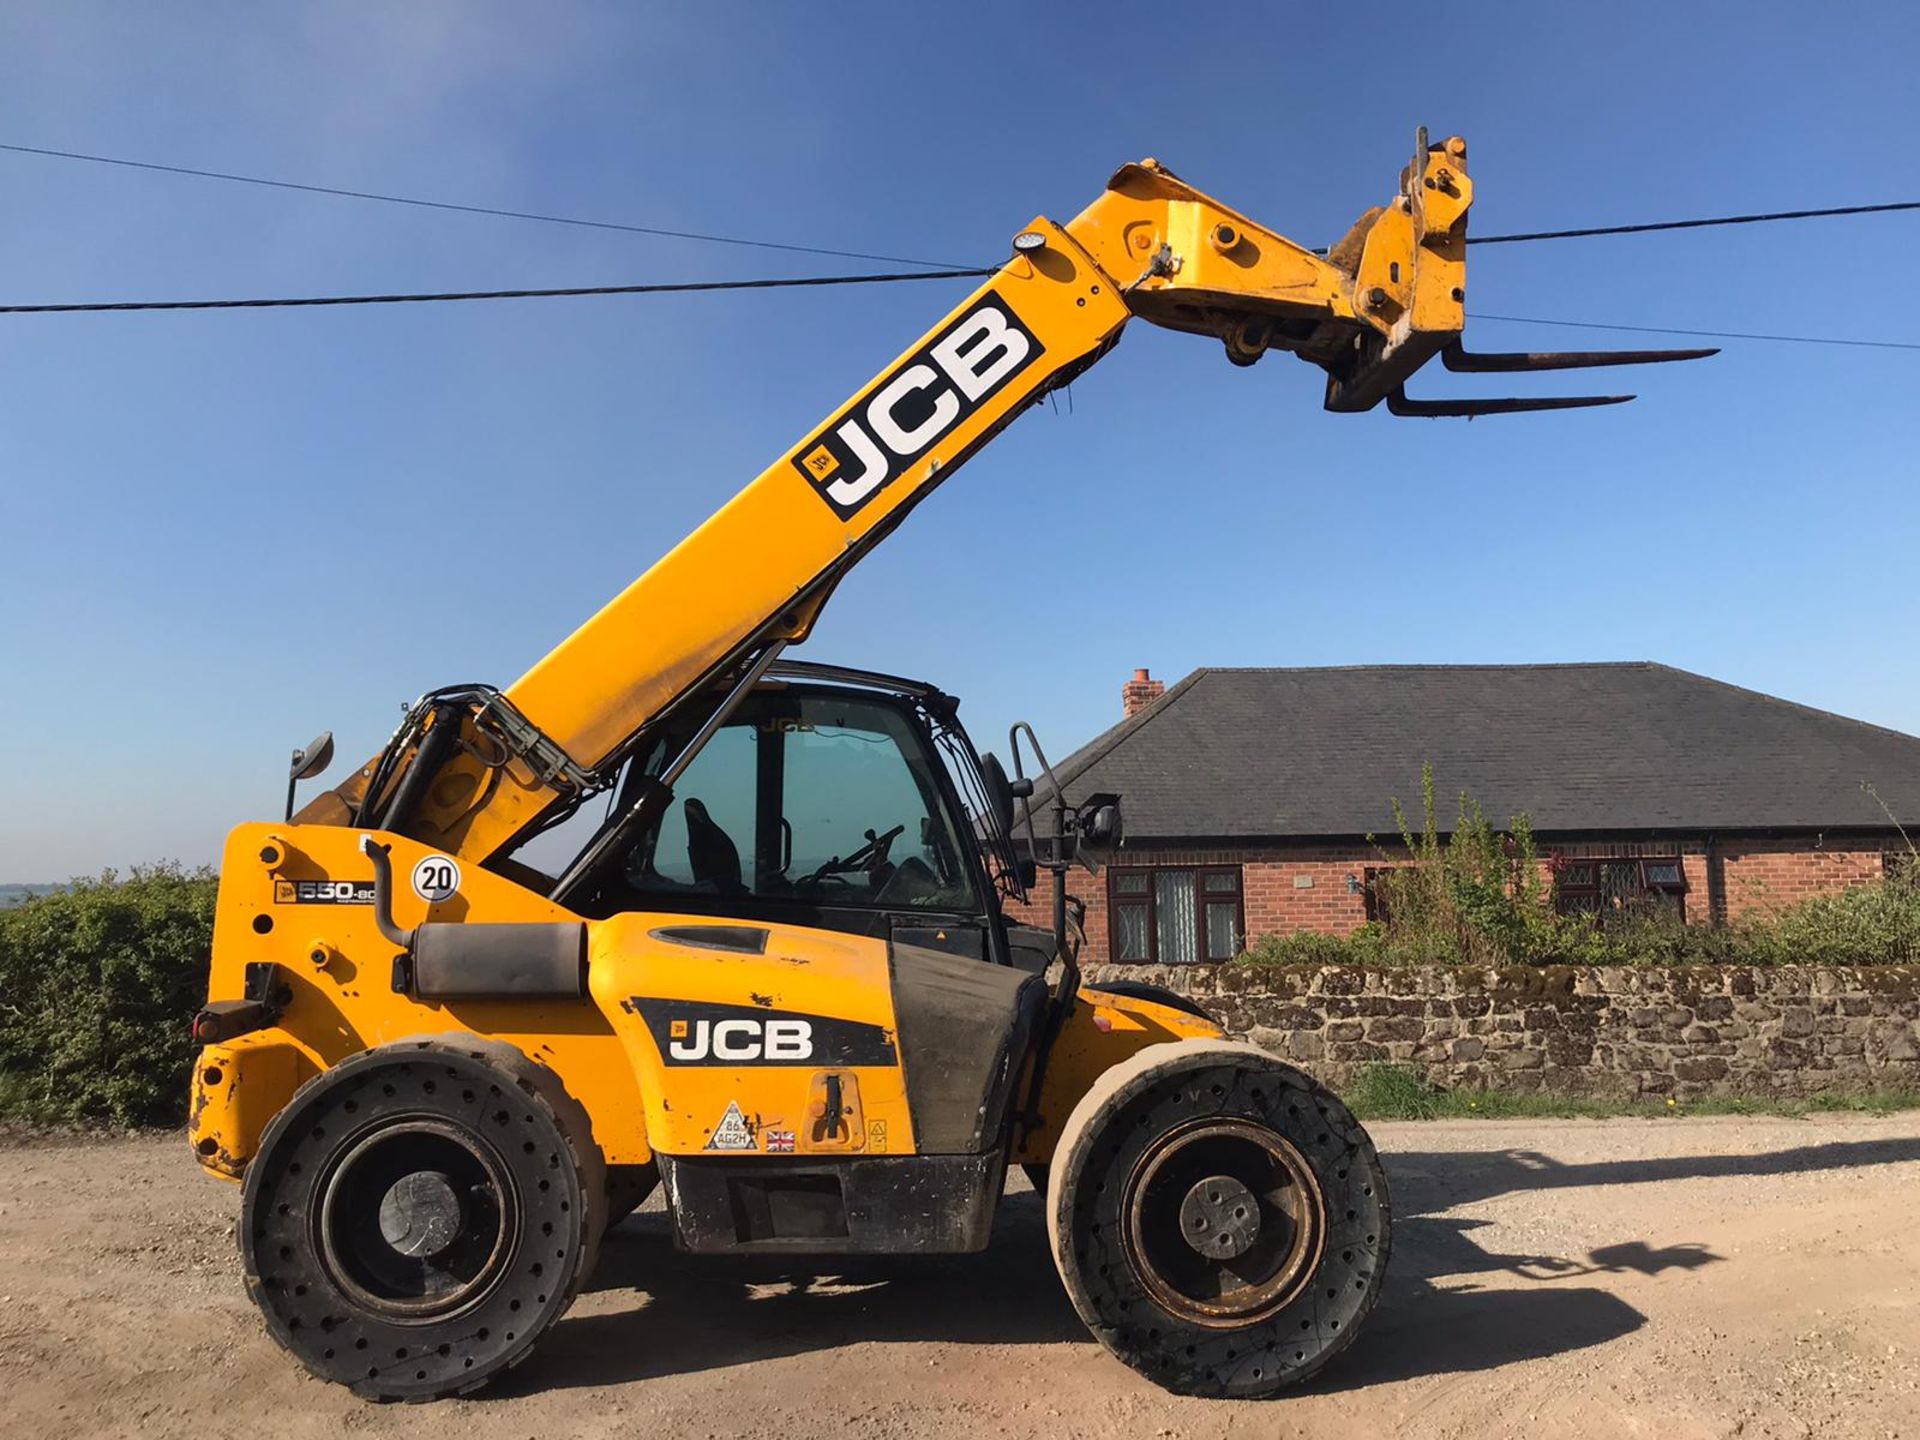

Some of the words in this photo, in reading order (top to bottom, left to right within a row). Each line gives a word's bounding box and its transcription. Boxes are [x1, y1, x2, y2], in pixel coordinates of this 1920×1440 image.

[826, 306, 1030, 506] JCB
[422, 866, 451, 890] 20
[670, 1019, 813, 1060] JCB
